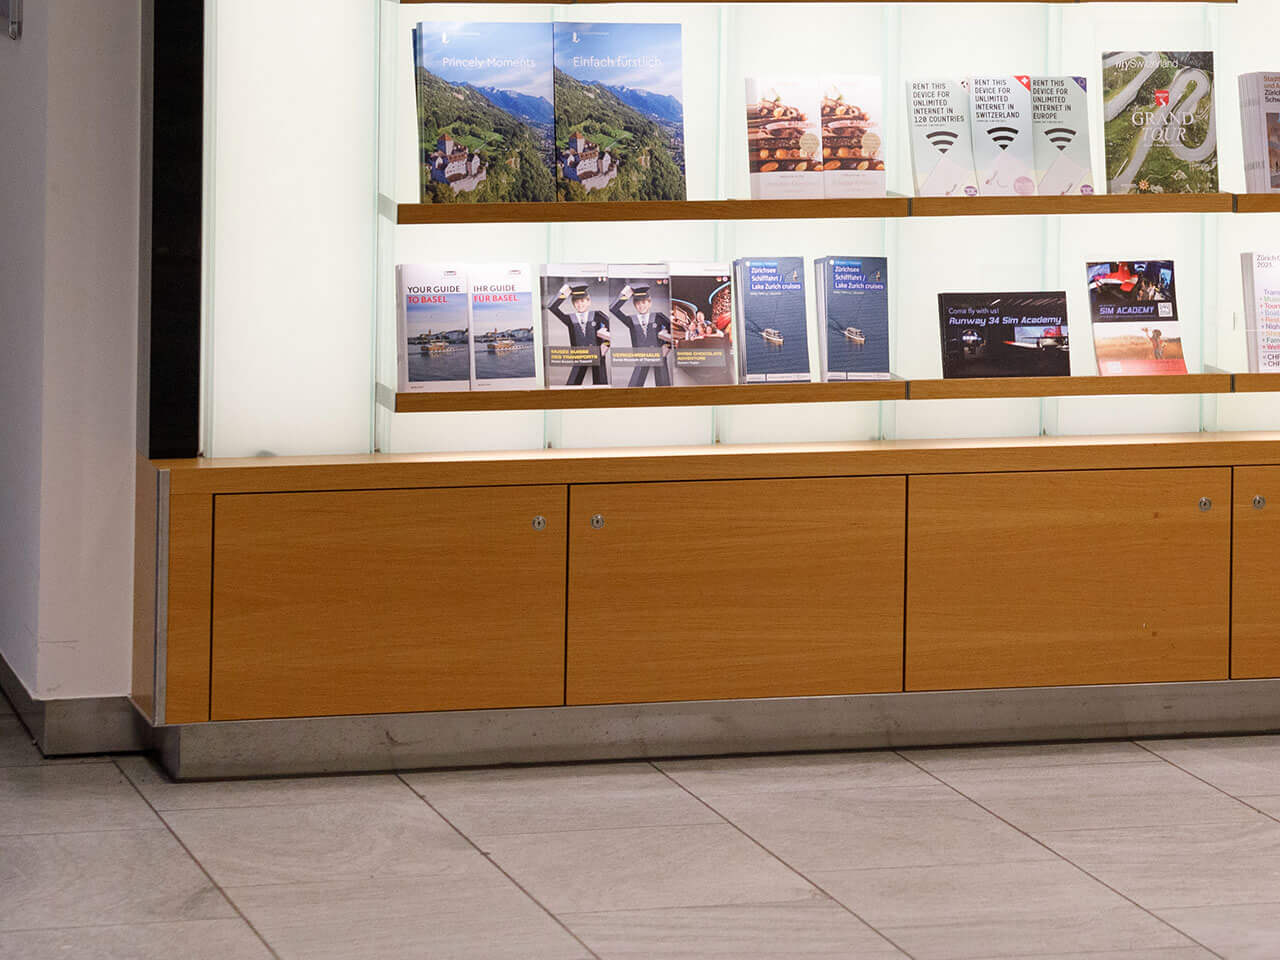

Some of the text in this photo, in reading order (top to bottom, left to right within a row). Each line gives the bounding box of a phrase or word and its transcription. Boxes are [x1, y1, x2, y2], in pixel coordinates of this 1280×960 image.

[441, 56, 537, 69] Princely Moments
[572, 55, 615, 68] Einfach
[912, 82, 947, 91] RENT THIS
[1032, 79, 1050, 87] RENT
[974, 87, 1011, 95] DEVICE FOR
[912, 99, 948, 107] UNLIMITED
[974, 95, 1009, 103] UNLIMITED
[913, 107, 954, 115] INTERNET IN
[975, 103, 1015, 111] INTERNET IN
[1032, 104, 1072, 112] INTERNET IN
[975, 111, 1020, 119] SWITZERLAND
[1032, 112, 1057, 120] EUROPE
[1131, 111, 1194, 126] GRAND
[914, 115, 965, 124] 120 COUNTRIES
[1142, 127, 1187, 143] TOUR
[751, 266, 777, 274] Zürichsee
[834, 265, 860, 273] Zürichsee
[407, 285, 461, 294] YOUR GUIDE
[489, 284, 516, 292] GUIDE
[407, 296, 420, 304] TO
[473, 294, 490, 303] FÜR
[967, 307, 975, 316] fly
[1099, 305, 1155, 315] SIM ACADEMY
[948, 316, 1062, 327] Runway 34 Sim Academy
